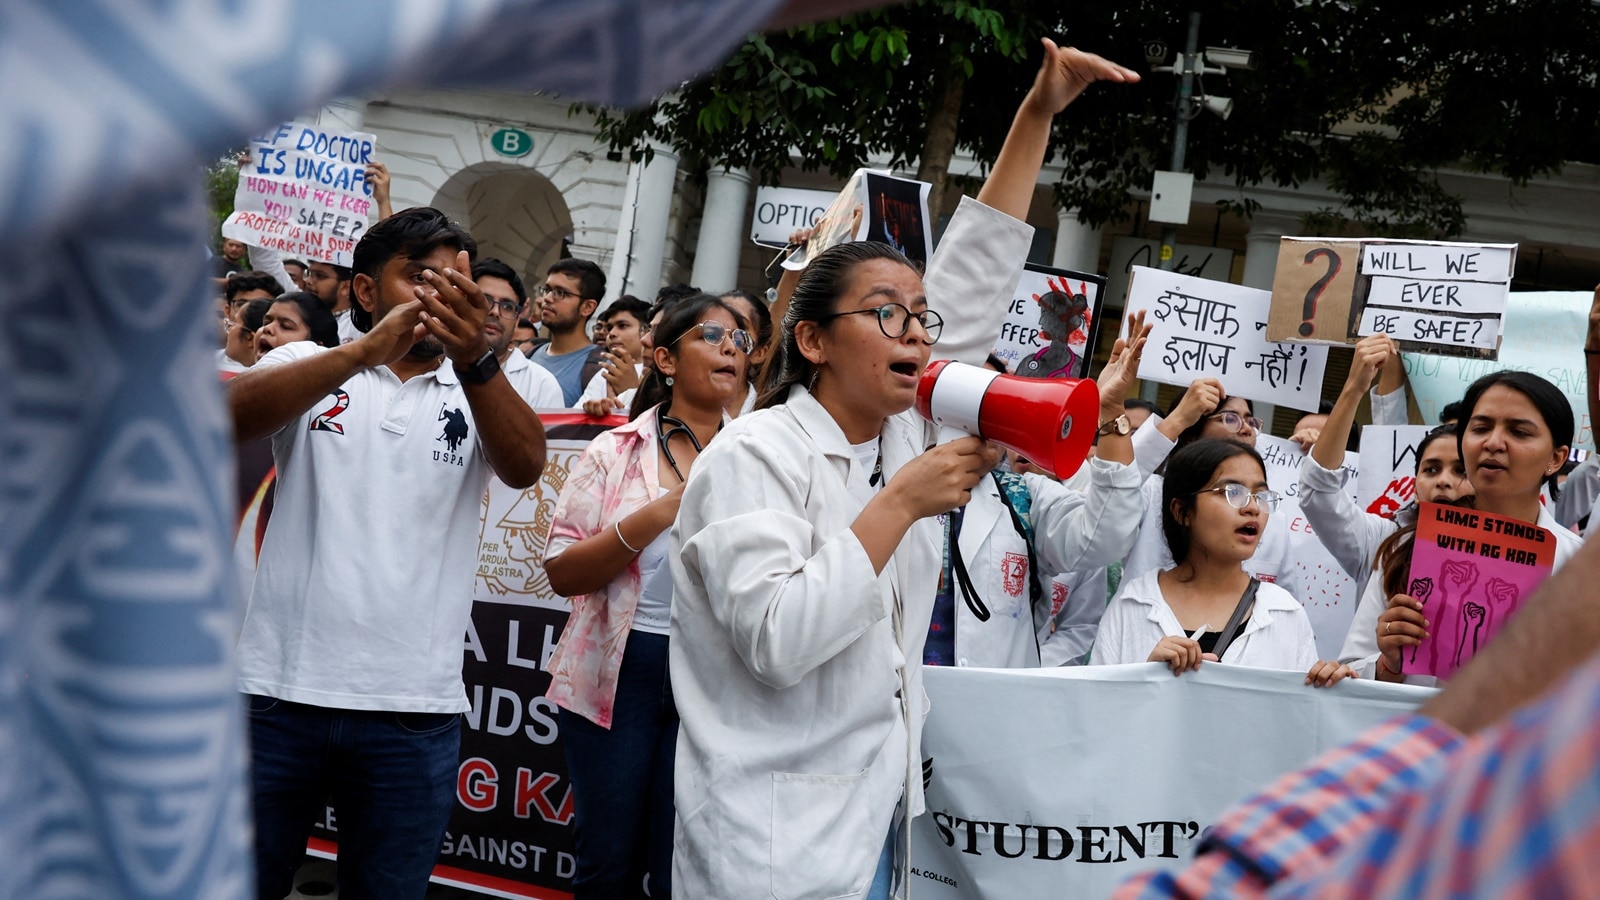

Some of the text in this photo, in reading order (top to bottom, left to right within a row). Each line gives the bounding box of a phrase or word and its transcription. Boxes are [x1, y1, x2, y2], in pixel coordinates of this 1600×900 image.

[296, 128, 372, 164] DOCTOR
[503, 131, 520, 152] B
[256, 148, 287, 175] IS
[247, 176, 278, 194] HOW
[282, 182, 309, 200] CAN
[313, 188, 336, 208] WE
[263, 199, 293, 221] YOU
[234, 212, 355, 253] PROTECT US IN OUR
[1370, 251, 1481, 275] WILL WE
[1401, 282, 1463, 307] EVER
[1373, 314, 1400, 334] BE
[1413, 318, 1483, 344] SAFE?
[1162, 335, 1237, 375] इलाज
[433, 450, 464, 467] USPA
[1436, 508, 1546, 543] LHMC STANDS
[479, 553, 509, 566] ARDUA
[482, 542, 499, 553] PER
[1437, 533, 1537, 567] WITH RG KAR
[477, 564, 524, 579] AD ASTRA
[923, 870, 958, 889] COLLEGE
